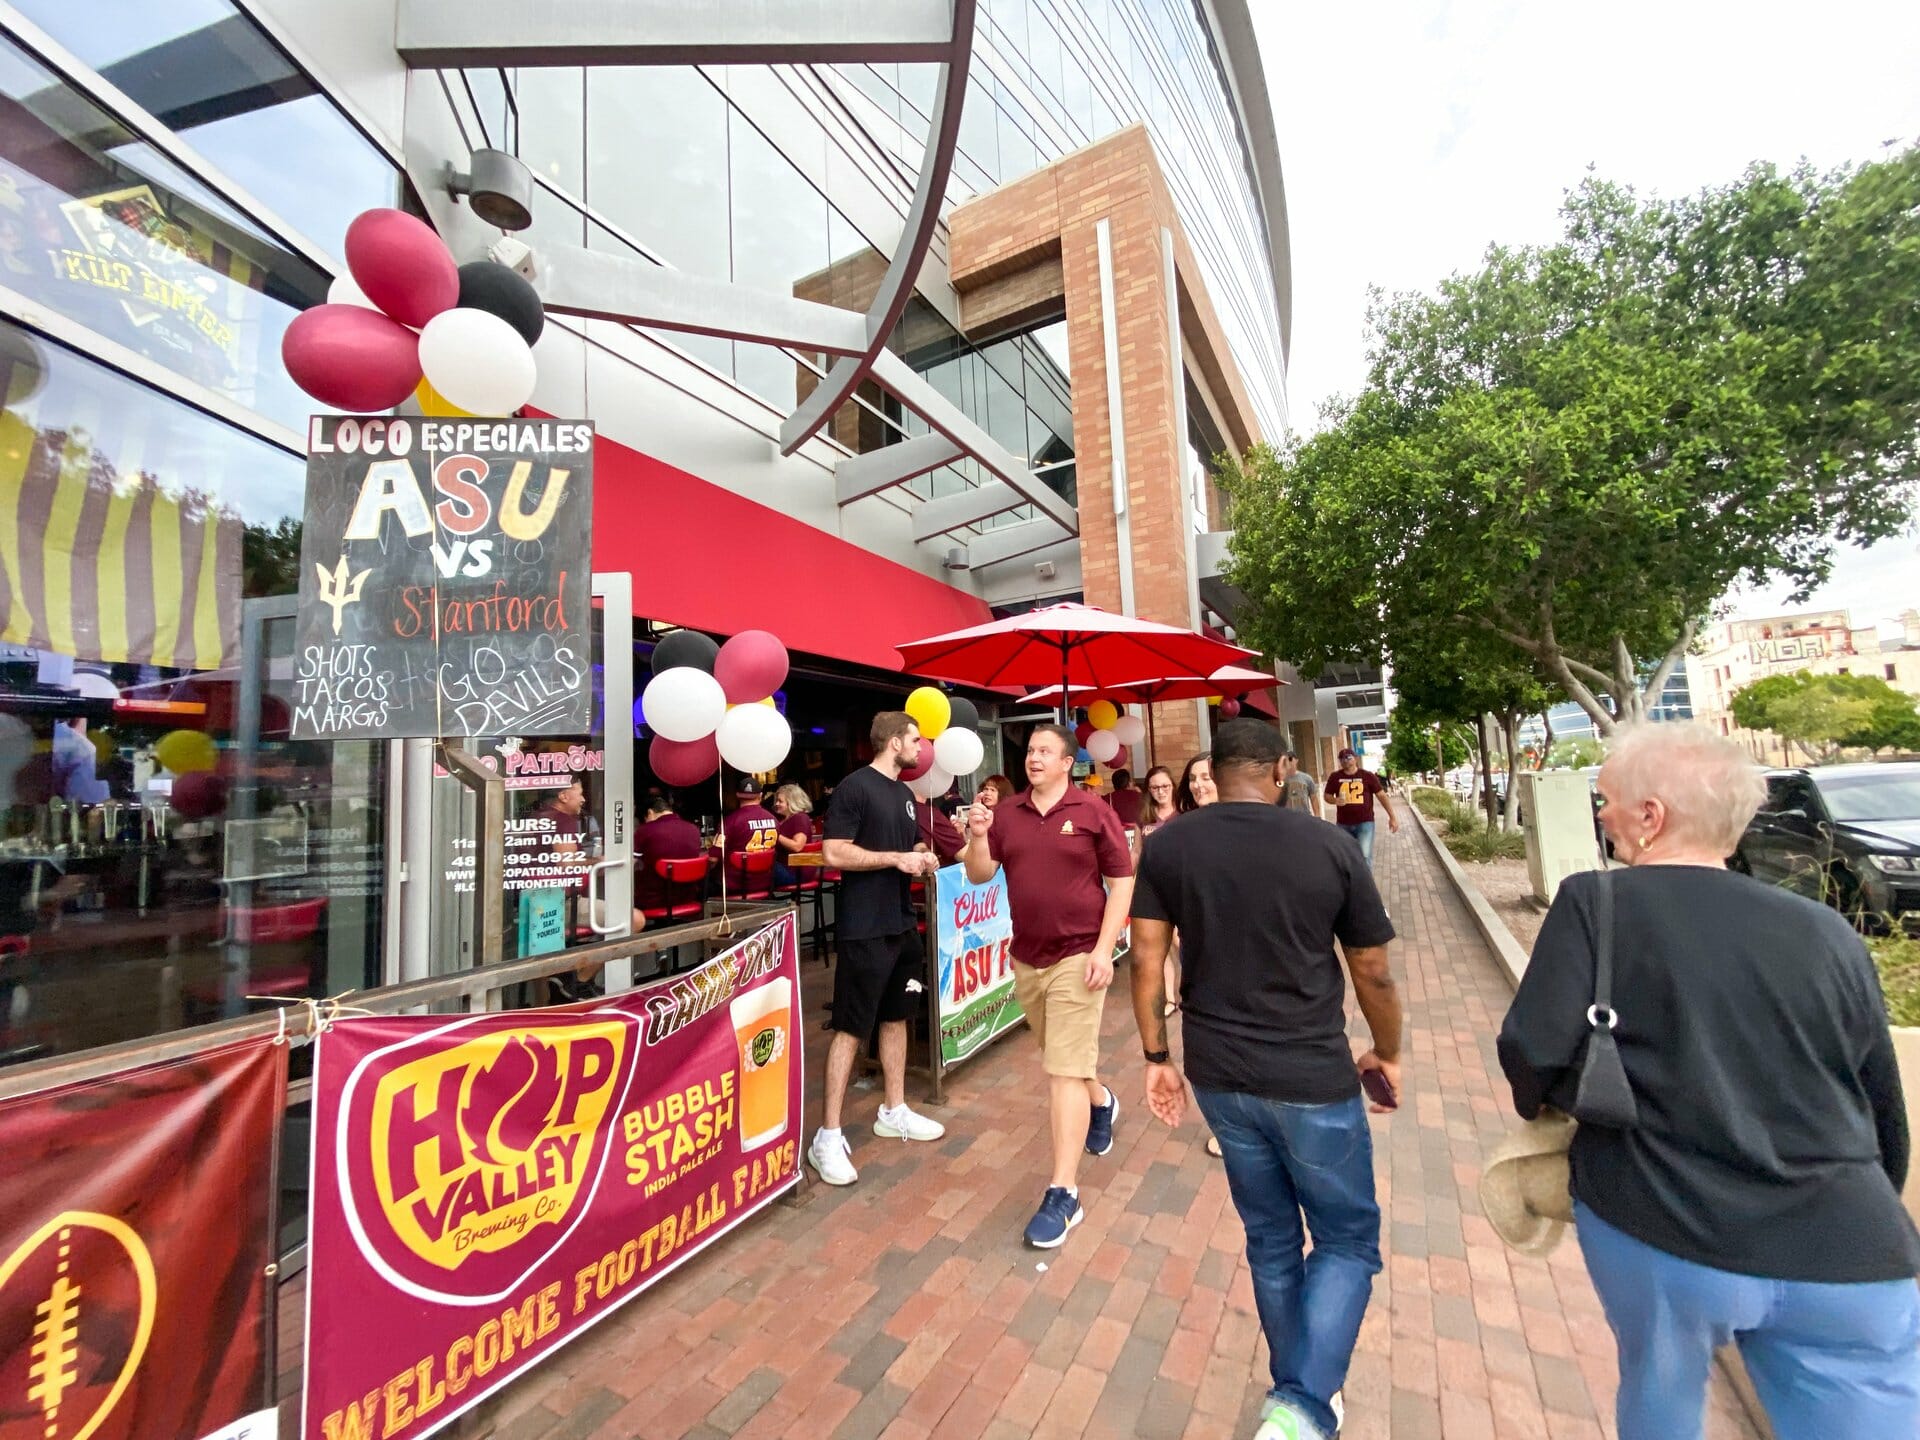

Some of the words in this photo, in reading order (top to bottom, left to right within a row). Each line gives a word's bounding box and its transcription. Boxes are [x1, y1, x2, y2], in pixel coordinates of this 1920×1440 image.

[62, 249, 133, 292] KILT
[142, 271, 234, 353] LIFTER
[311, 418, 412, 455] LOCO
[421, 422, 592, 453] ESPECIALES
[342, 454, 570, 541] ASU
[429, 539, 493, 578] VS
[395, 571, 568, 640] Stanford
[299, 645, 376, 678] SHOTS
[440, 647, 505, 701] GO
[292, 701, 389, 735] MARGS
[296, 676, 388, 705] TACOS
[455, 648, 580, 736] DEVILS
[533, 777, 568, 785] GRILL
[505, 836, 536, 847] 2am
[542, 833, 586, 845] DAILY
[615, 803, 623, 834] PULL
[745, 829, 778, 852] 42
[748, 818, 776, 830] TILLMAN
[954, 884, 1000, 929] Chill
[645, 952, 741, 1046] GAME
[739, 920, 787, 986] ON!
[952, 943, 994, 1003] ASU
[387, 1033, 615, 1203] HOP
[623, 1070, 735, 1143] BUBBLE
[625, 1097, 735, 1185] STASH
[644, 1170, 677, 1198] INDIA
[679, 1156, 705, 1182] PALE
[705, 1140, 723, 1165] ALE
[411, 1132, 582, 1242] VALLEY
[453, 1213, 530, 1252] Brewing
[534, 1195, 562, 1223] Co.
[321, 1280, 562, 1440] WELCOME
[572, 1180, 726, 1316] FOOTBALL
[733, 1137, 795, 1208] FANS
